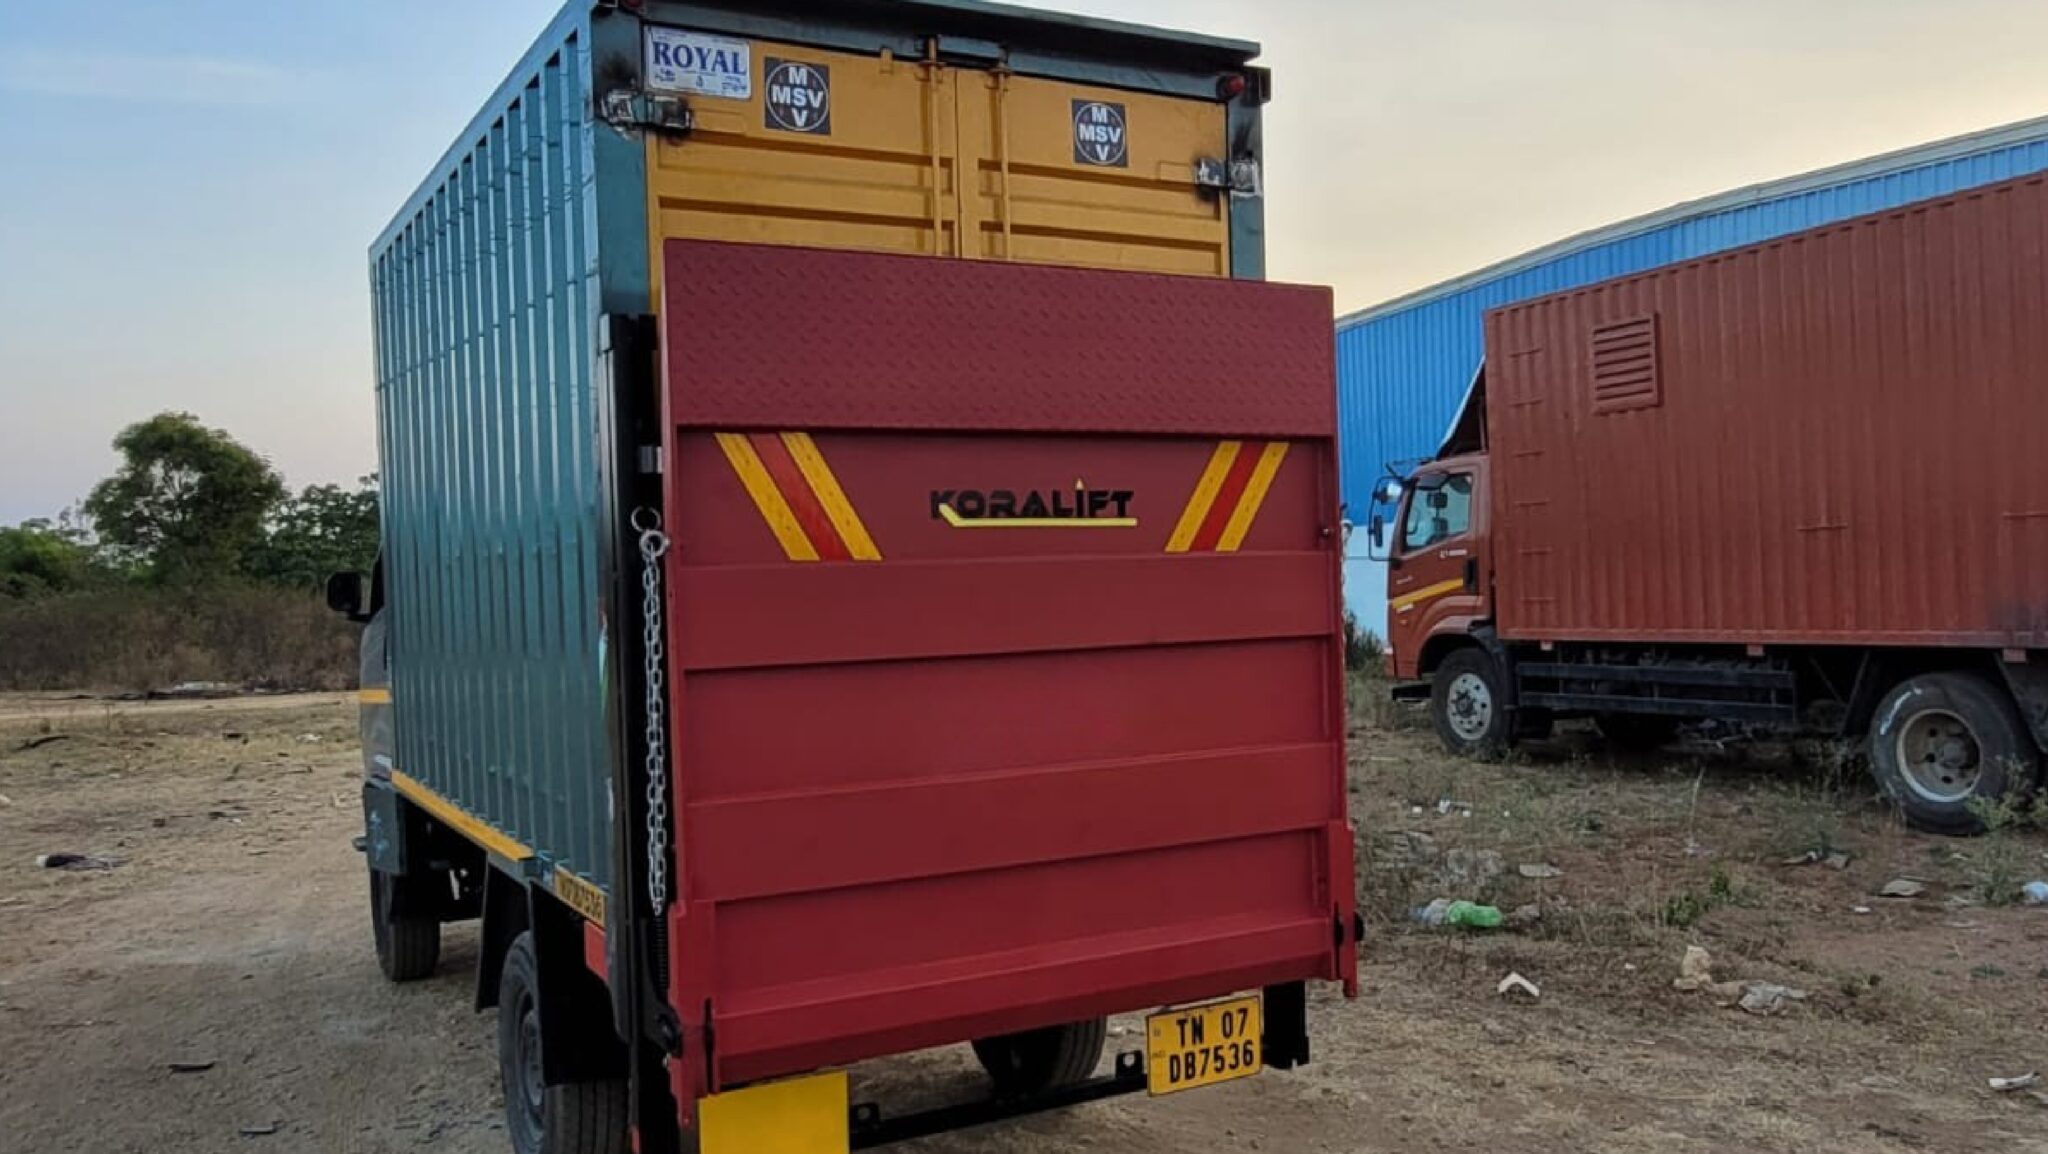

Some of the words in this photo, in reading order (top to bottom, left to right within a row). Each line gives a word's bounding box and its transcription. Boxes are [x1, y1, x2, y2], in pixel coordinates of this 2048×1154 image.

[653, 41, 747, 75] ROYAL
[789, 66, 808, 85] M
[772, 85, 824, 108] MSV
[791, 109, 808, 127] V
[1091, 106, 1107, 123] M
[1079, 123, 1121, 143] MSV
[1095, 144, 1110, 161] V
[930, 478, 1135, 519] KORALIFT
[1177, 1016, 1204, 1047] TN
[1222, 1008, 1248, 1038] 07
[1170, 1040, 1253, 1083] DB7536
